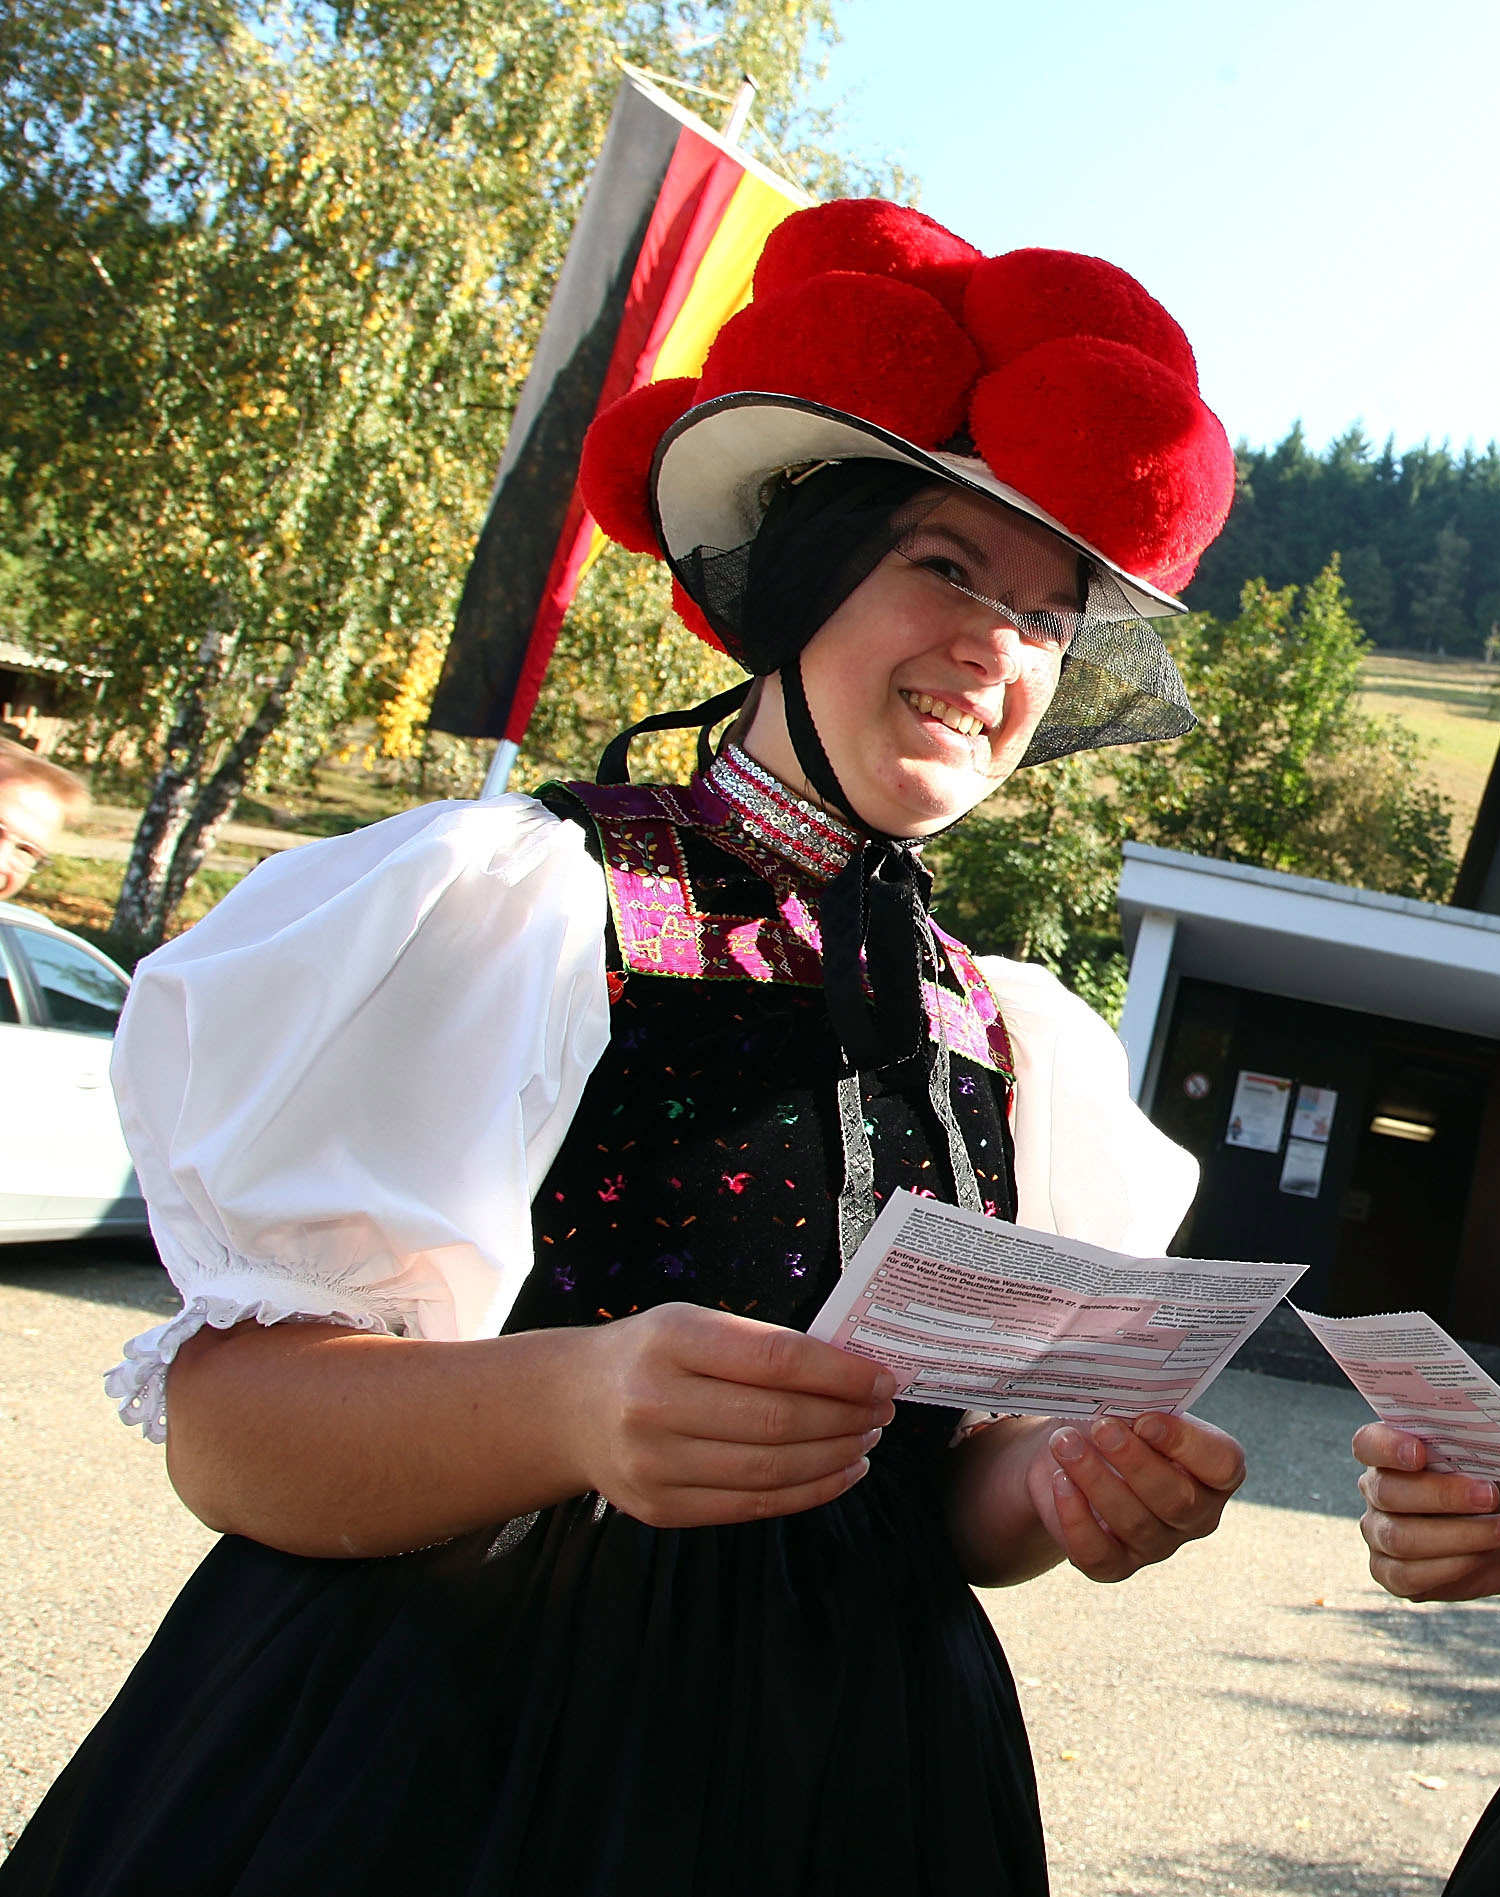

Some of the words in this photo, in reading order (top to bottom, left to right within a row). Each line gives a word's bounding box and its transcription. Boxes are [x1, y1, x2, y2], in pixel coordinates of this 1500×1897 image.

[886, 1256, 900, 1264] für
[900, 1260, 915, 1270] die
[916, 1265, 938, 1277] Wahl
[938, 1273, 958, 1282] zum
[959, 1278, 1005, 1293] Deutschen
[1005, 1288, 1050, 1301] Bundestag
[1050, 1296, 1064, 1304] am
[1078, 1304, 1120, 1312] September
[890, 1250, 921, 1264] Antrag
[921, 1260, 938, 1268] auf
[937, 1264, 976, 1280] Erteilung
[977, 1273, 1001, 1285] eines
[1002, 1280, 1054, 1294] Wahlscheins
